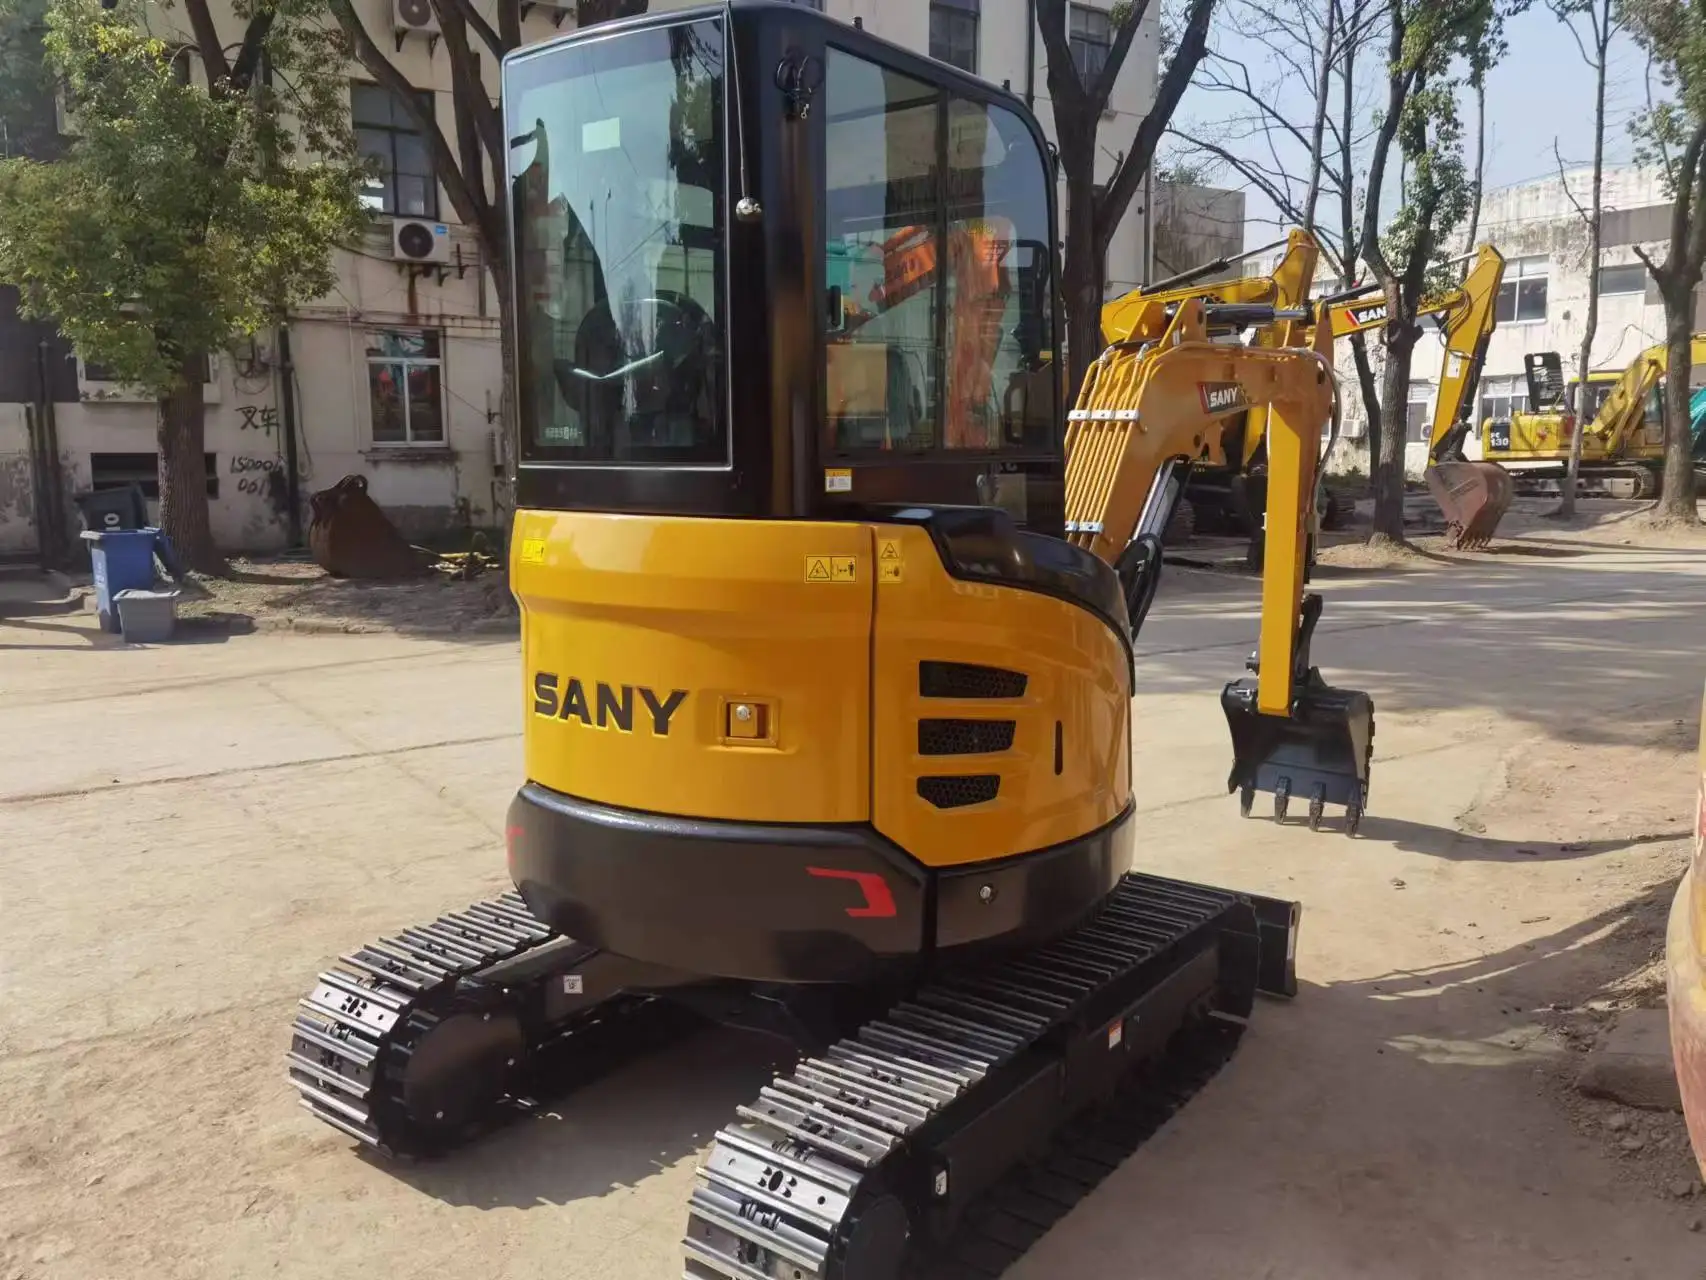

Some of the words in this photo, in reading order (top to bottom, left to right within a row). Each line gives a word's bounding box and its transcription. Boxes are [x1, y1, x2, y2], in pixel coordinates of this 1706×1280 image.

[1358, 306, 1387, 323] SAN
[1209, 387, 1238, 408] SANY
[234, 404, 280, 437] 叉车
[1490, 437, 1509, 447] 130
[534, 671, 690, 737] SANY
